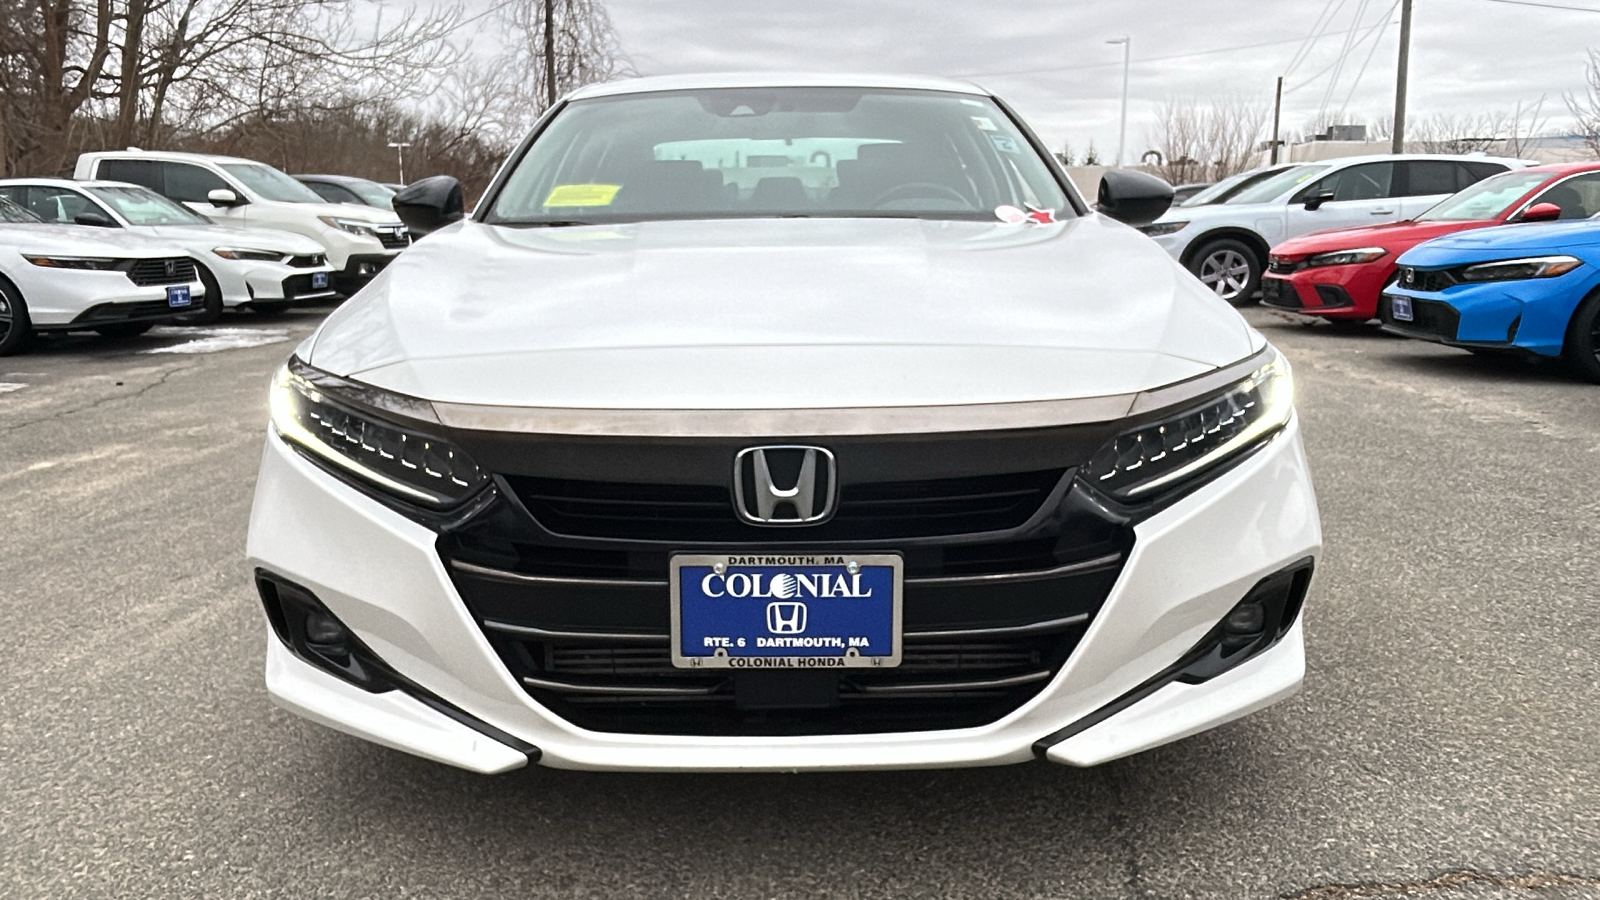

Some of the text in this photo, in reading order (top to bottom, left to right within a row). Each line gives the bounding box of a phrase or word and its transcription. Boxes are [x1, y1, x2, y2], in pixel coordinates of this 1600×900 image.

[824, 556, 845, 565] MA
[701, 573, 872, 599] COLONIAL
[703, 637, 870, 649] RTE. 6 DARTMOUTH, MA
[728, 658, 845, 667] COLONIAL HONDA
